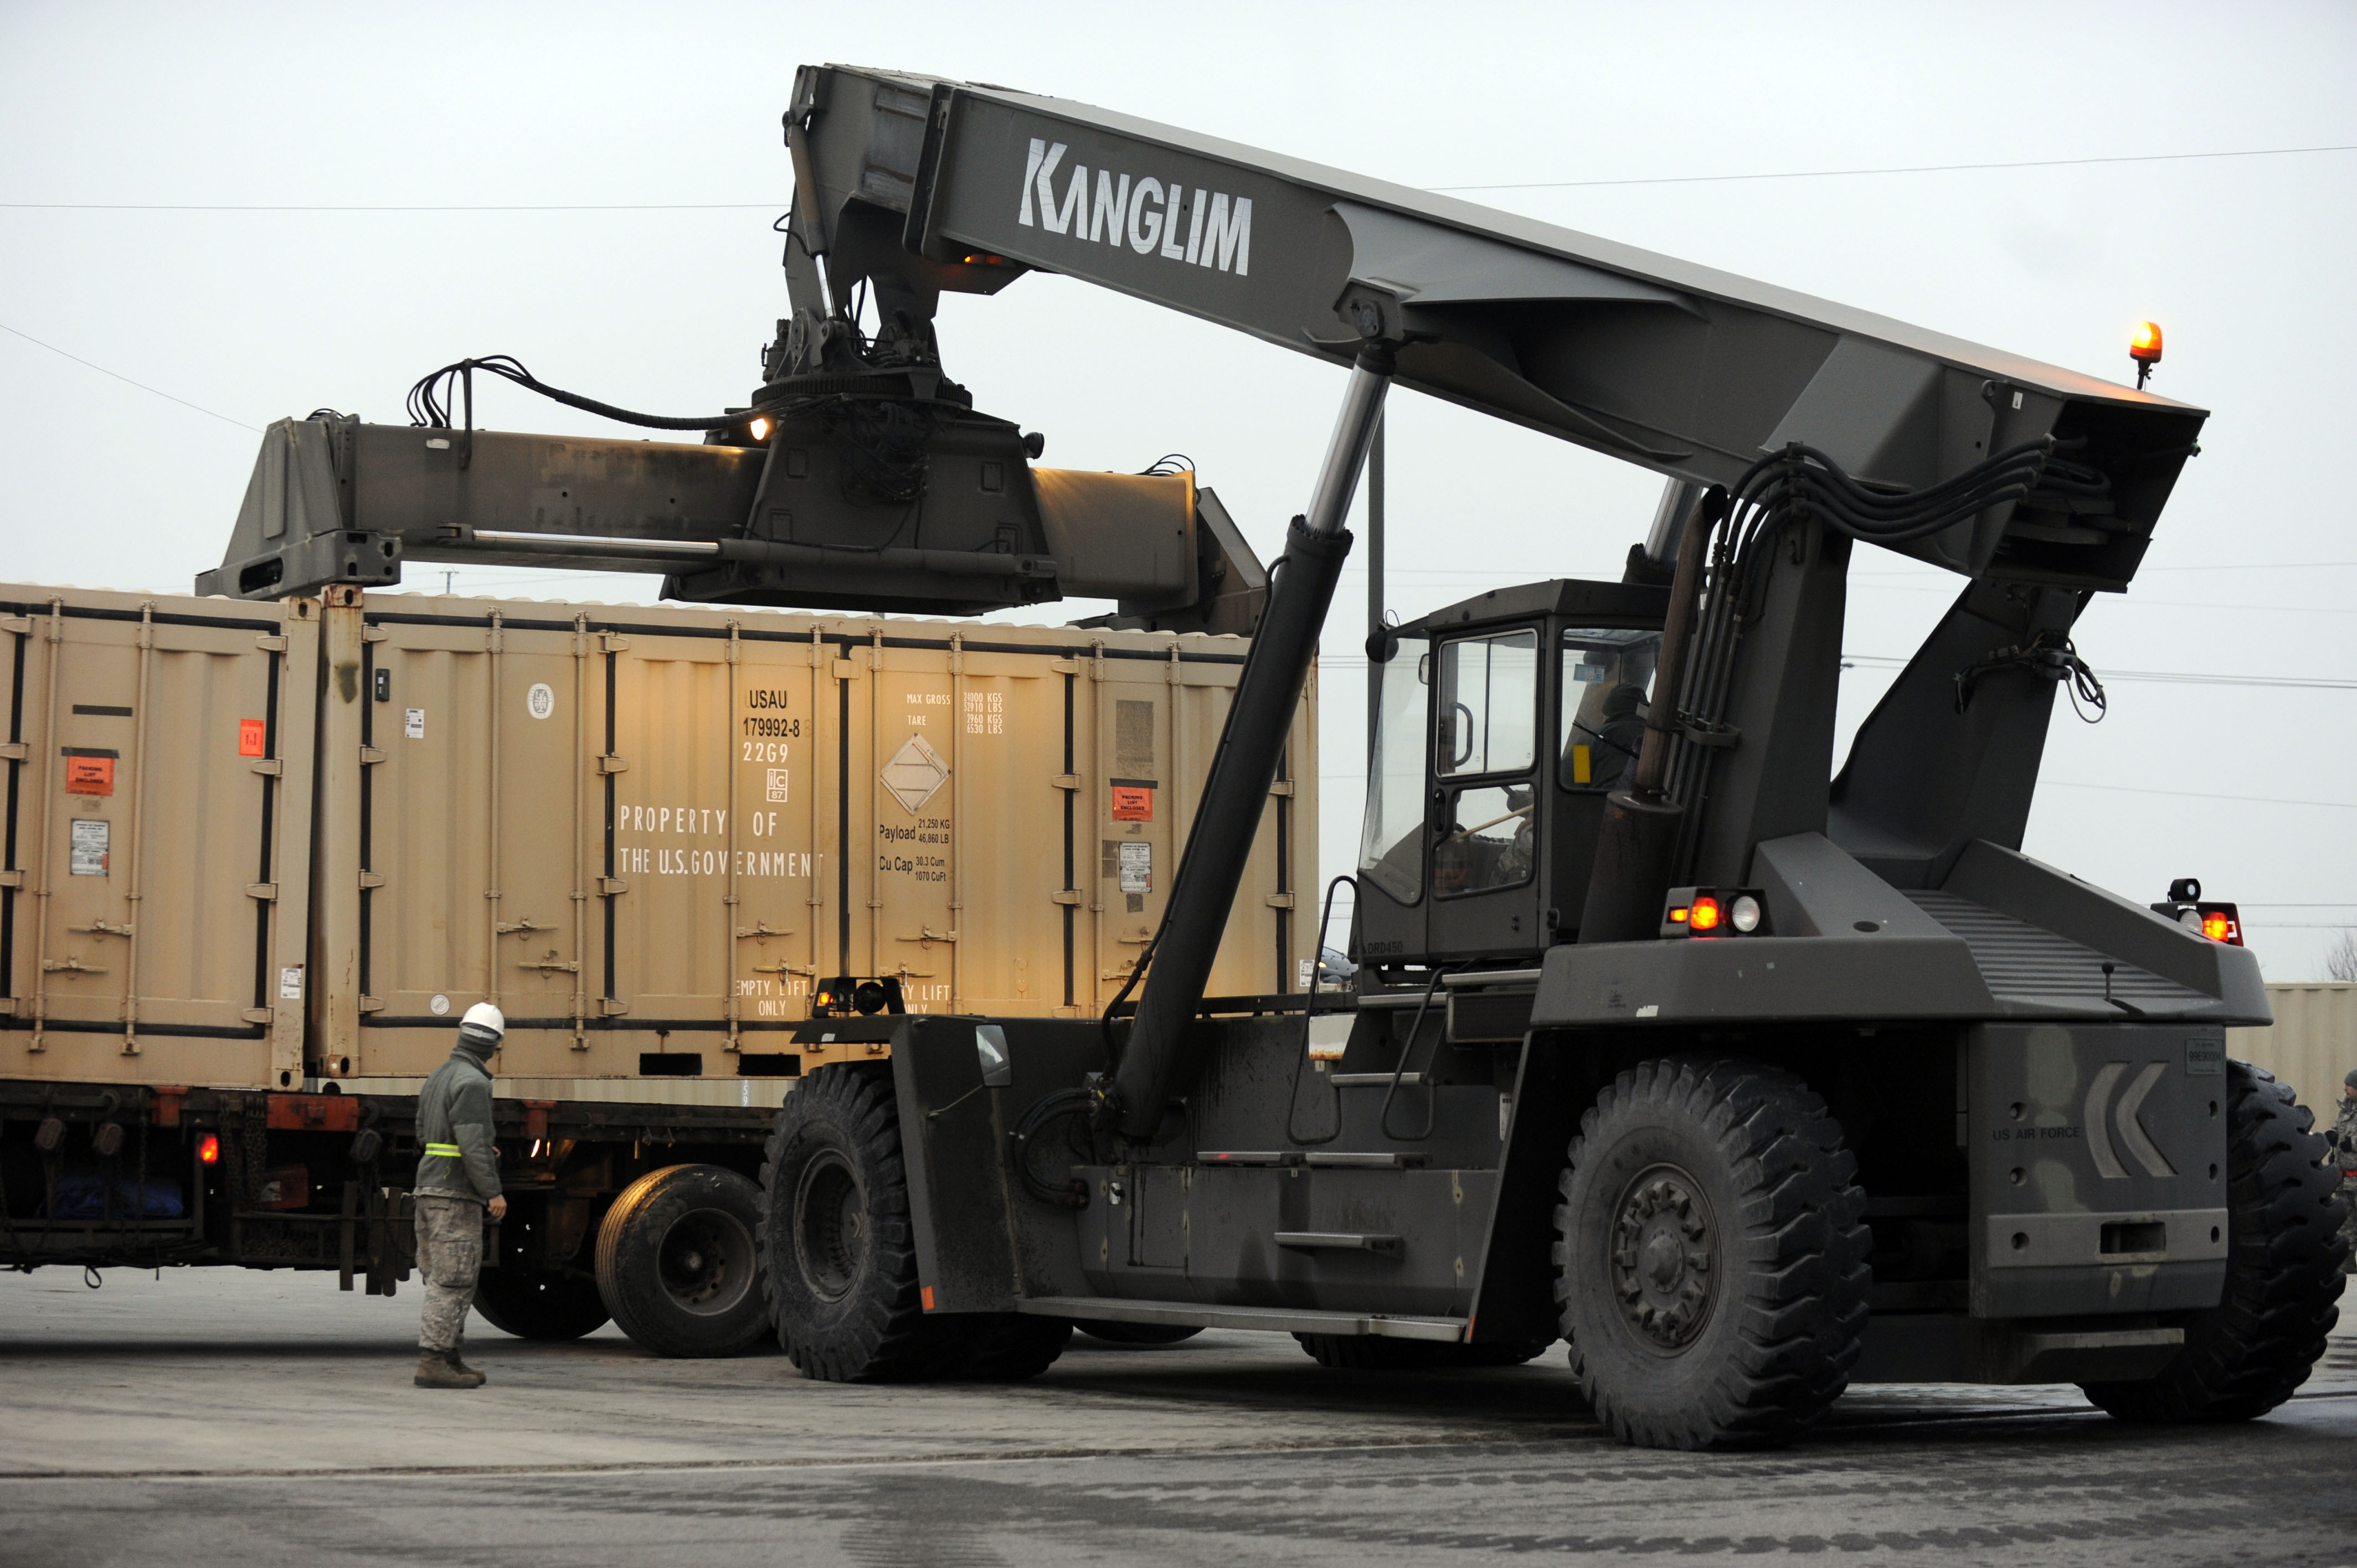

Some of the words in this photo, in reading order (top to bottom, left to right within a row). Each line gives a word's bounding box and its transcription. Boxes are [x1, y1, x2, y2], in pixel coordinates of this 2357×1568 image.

[1019, 138, 1252, 276] KANGLIM
[749, 690, 787, 709] USAU
[907, 694, 922, 704] MAX
[925, 694, 951, 705] GROSS
[964, 692, 983, 702] 24000
[987, 693, 1002, 703] KGS
[964, 702, 983, 712] 52910
[988, 703, 1002, 713] LBS
[907, 715, 927, 725] TARE
[967, 714, 983, 724] 2960
[987, 714, 1002, 724] KGS
[743, 718, 800, 737] 179992-8
[966, 724, 983, 734] 6530
[988, 724, 1003, 734] LBS
[743, 742, 788, 763] 22G9
[771, 791, 784, 800] 87
[620, 805, 727, 834] PROPERTY
[753, 812, 777, 837] OF
[879, 824, 915, 843] Payload
[918, 818, 939, 830] 21,250
[940, 819, 950, 829] KG
[918, 833, 939, 844] 46,860
[940, 834, 949, 844] LB
[620, 848, 650, 873] THE
[879, 856, 892, 871] Cu
[894, 857, 913, 875] Cap
[915, 857, 929, 866] 30.3
[915, 871, 930, 881] 1070
[779, 981, 807, 996] LIFT
[923, 985, 950, 1000] LIFT
[759, 1000, 786, 1017] ONLY
[1993, 1129, 2010, 1141] US
[2016, 1128, 2035, 1139] AIR
[2041, 1127, 2081, 1139] FORCE
